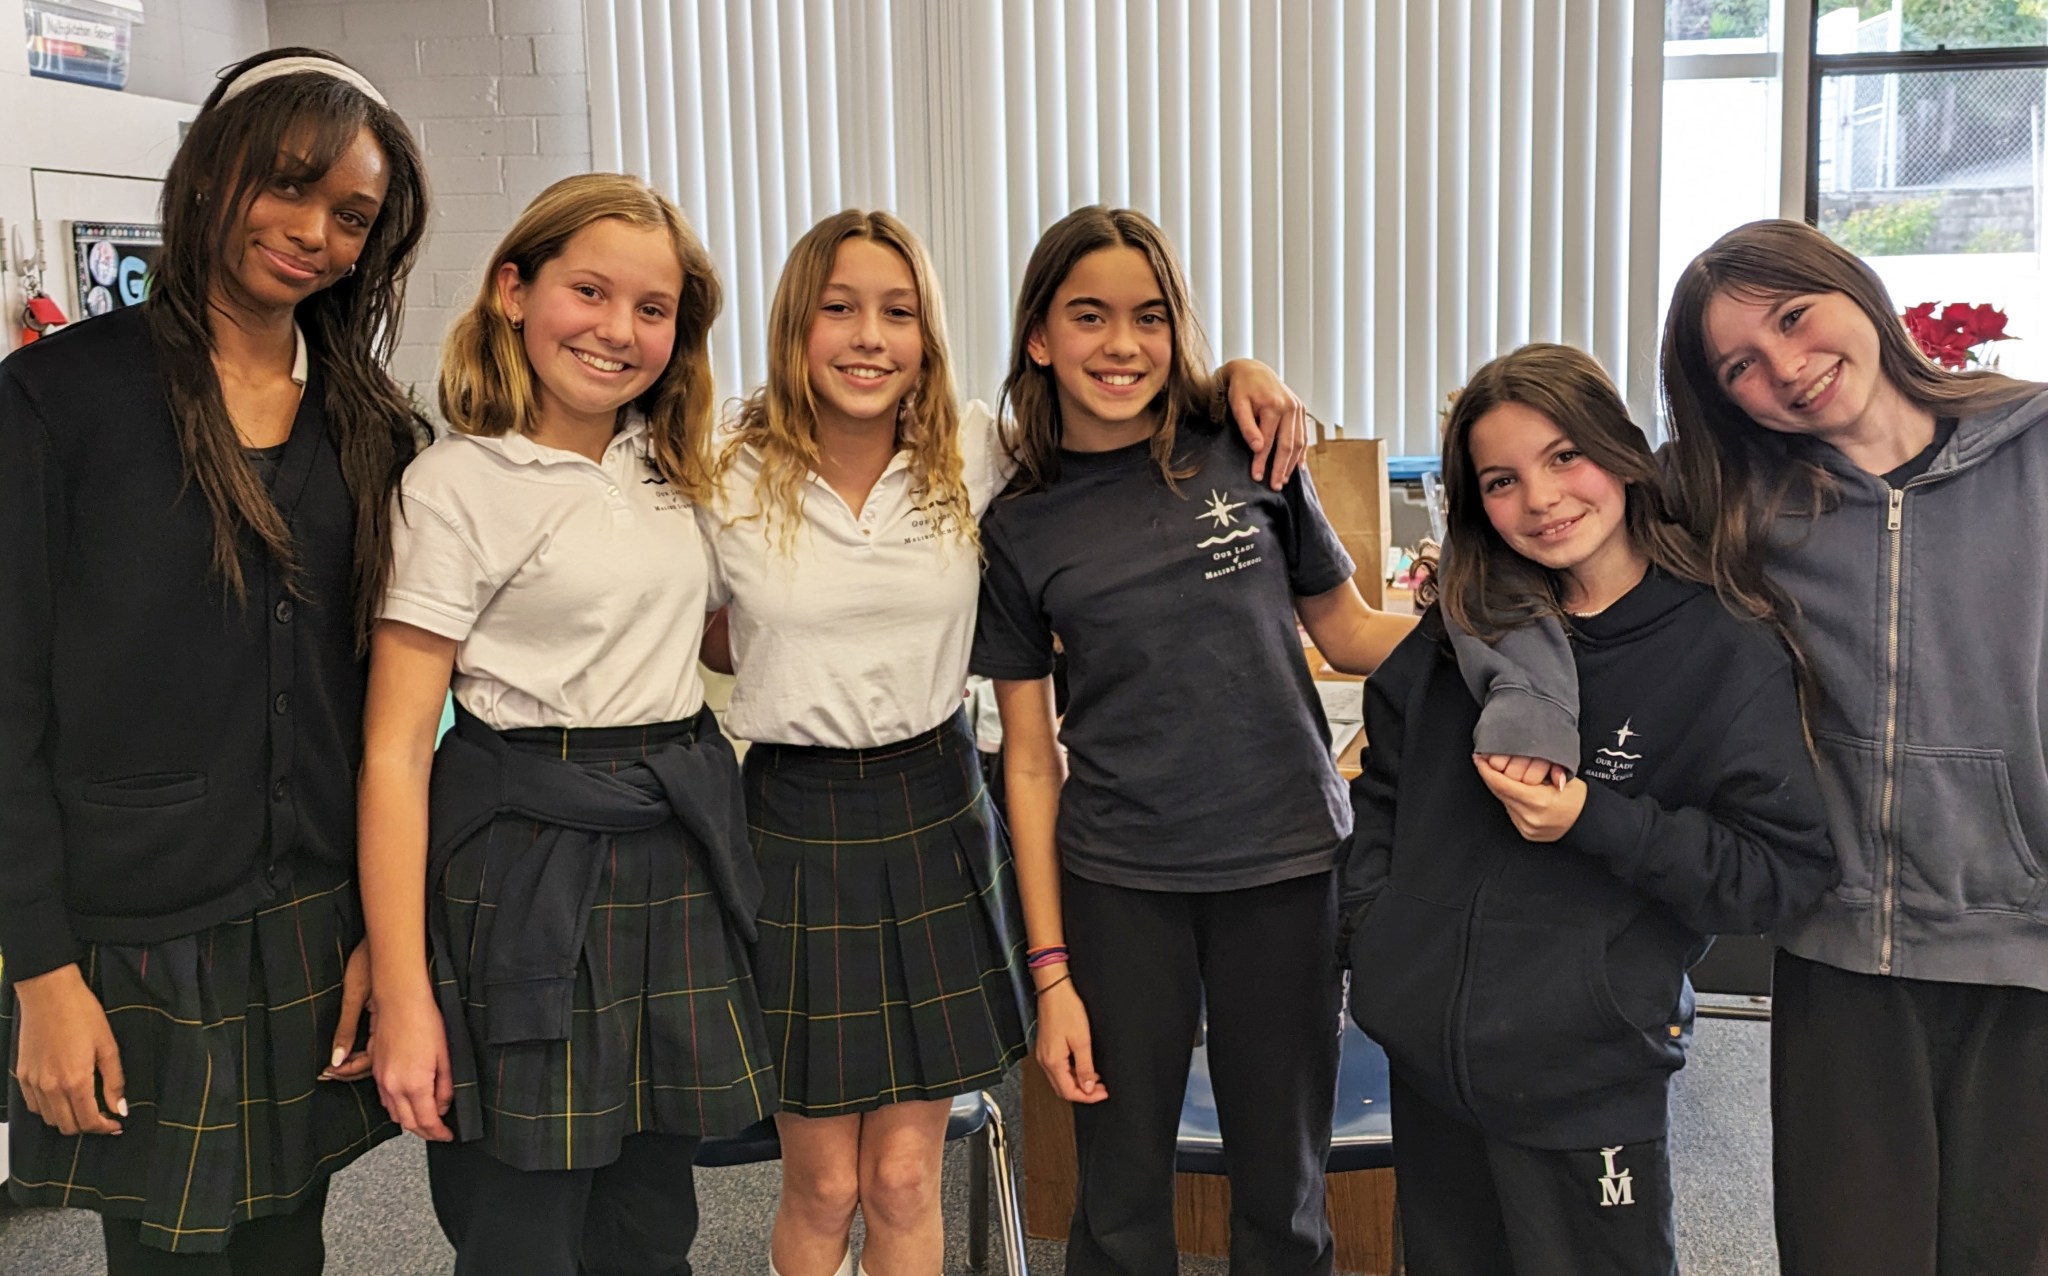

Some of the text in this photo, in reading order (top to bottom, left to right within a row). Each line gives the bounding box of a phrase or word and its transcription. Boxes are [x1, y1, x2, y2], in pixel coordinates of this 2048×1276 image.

[1213, 543, 1255, 561] OUR LADY
[1204, 556, 1262, 580] MALIBU SCHOOL
[1595, 757, 1634, 770] OUR LADY
[1584, 769, 1611, 780] MALIBU
